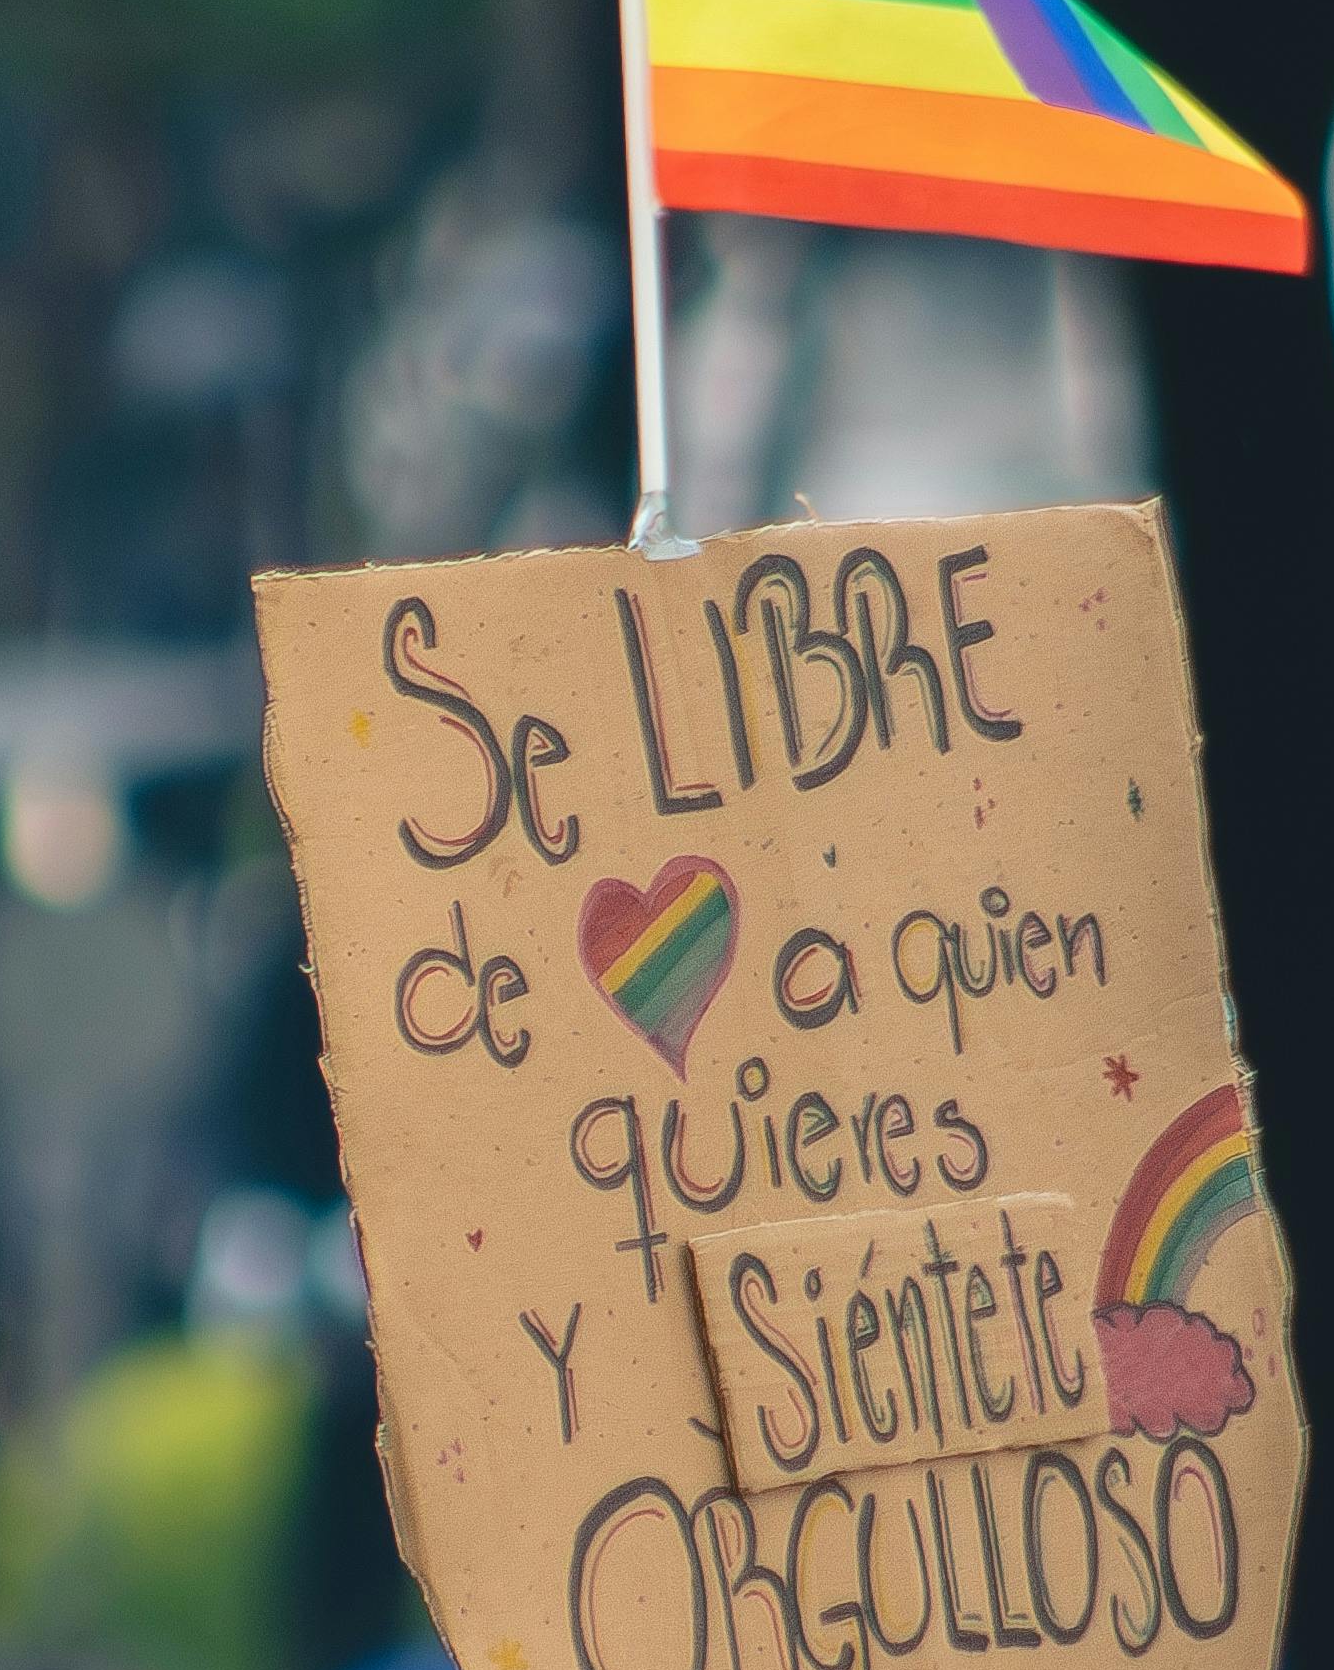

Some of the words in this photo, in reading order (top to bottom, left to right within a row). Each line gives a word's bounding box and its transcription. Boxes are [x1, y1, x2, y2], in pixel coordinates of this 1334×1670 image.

[383, 597, 581, 871] Se
[615, 546, 1024, 815] LIBRE
[395, 901, 531, 1068] de
[772, 928, 863, 1030] a
[892, 887, 1107, 1055] quien
[569, 1057, 990, 1303] quieres
[728, 1208, 1087, 1473] Siéntete
